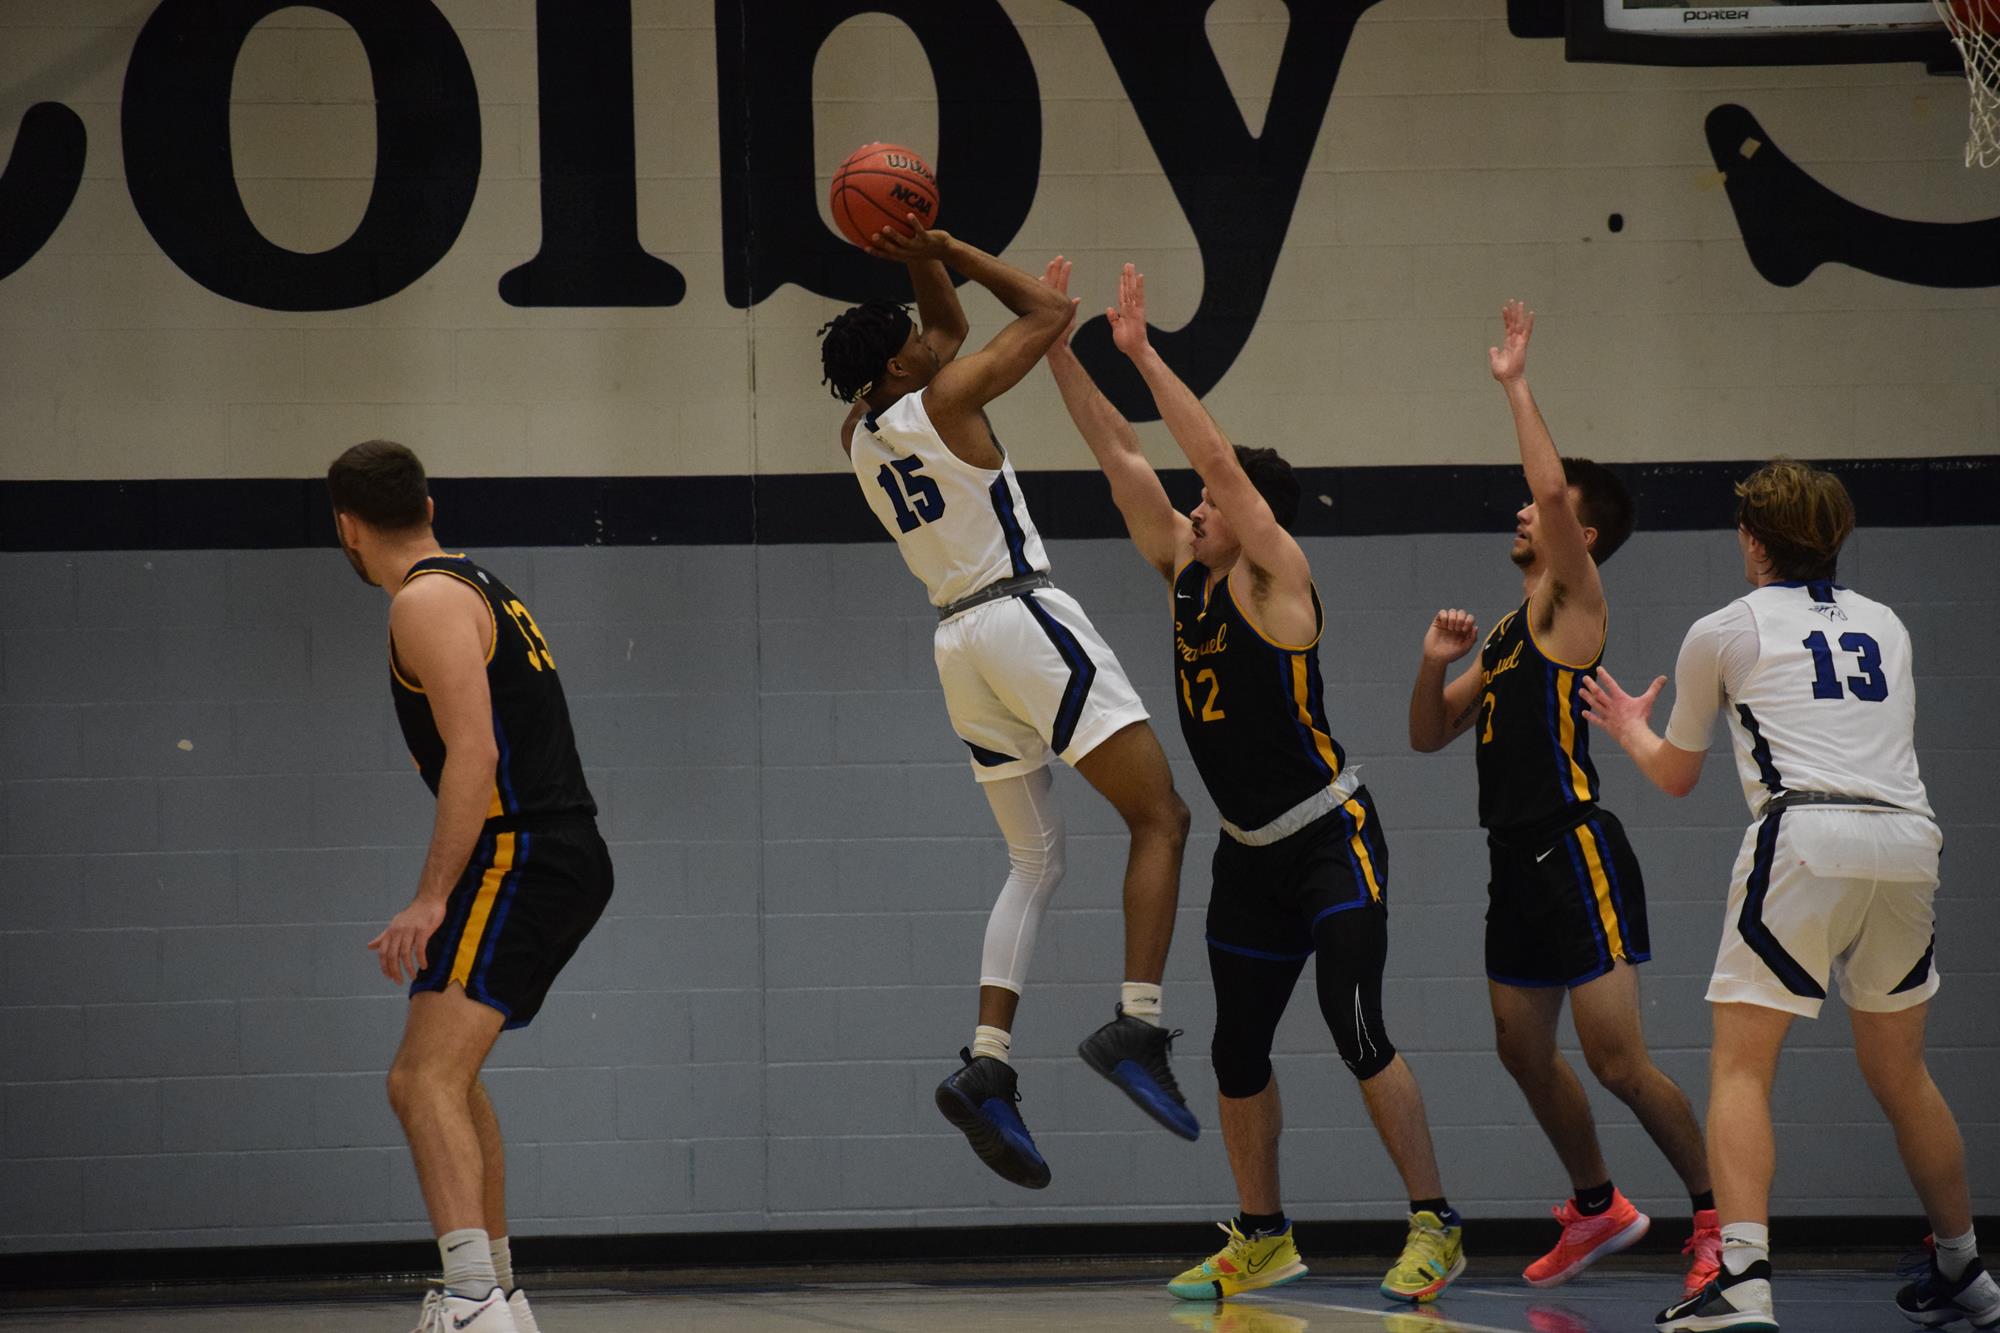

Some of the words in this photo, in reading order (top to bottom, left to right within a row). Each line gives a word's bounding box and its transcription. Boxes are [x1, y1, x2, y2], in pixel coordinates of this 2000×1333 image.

[0, 0, 1390, 421] olby
[889, 182, 932, 216] NCAA
[876, 453, 945, 534] 15
[1180, 668, 1226, 722] 12
[1802, 630, 1889, 702] 13
